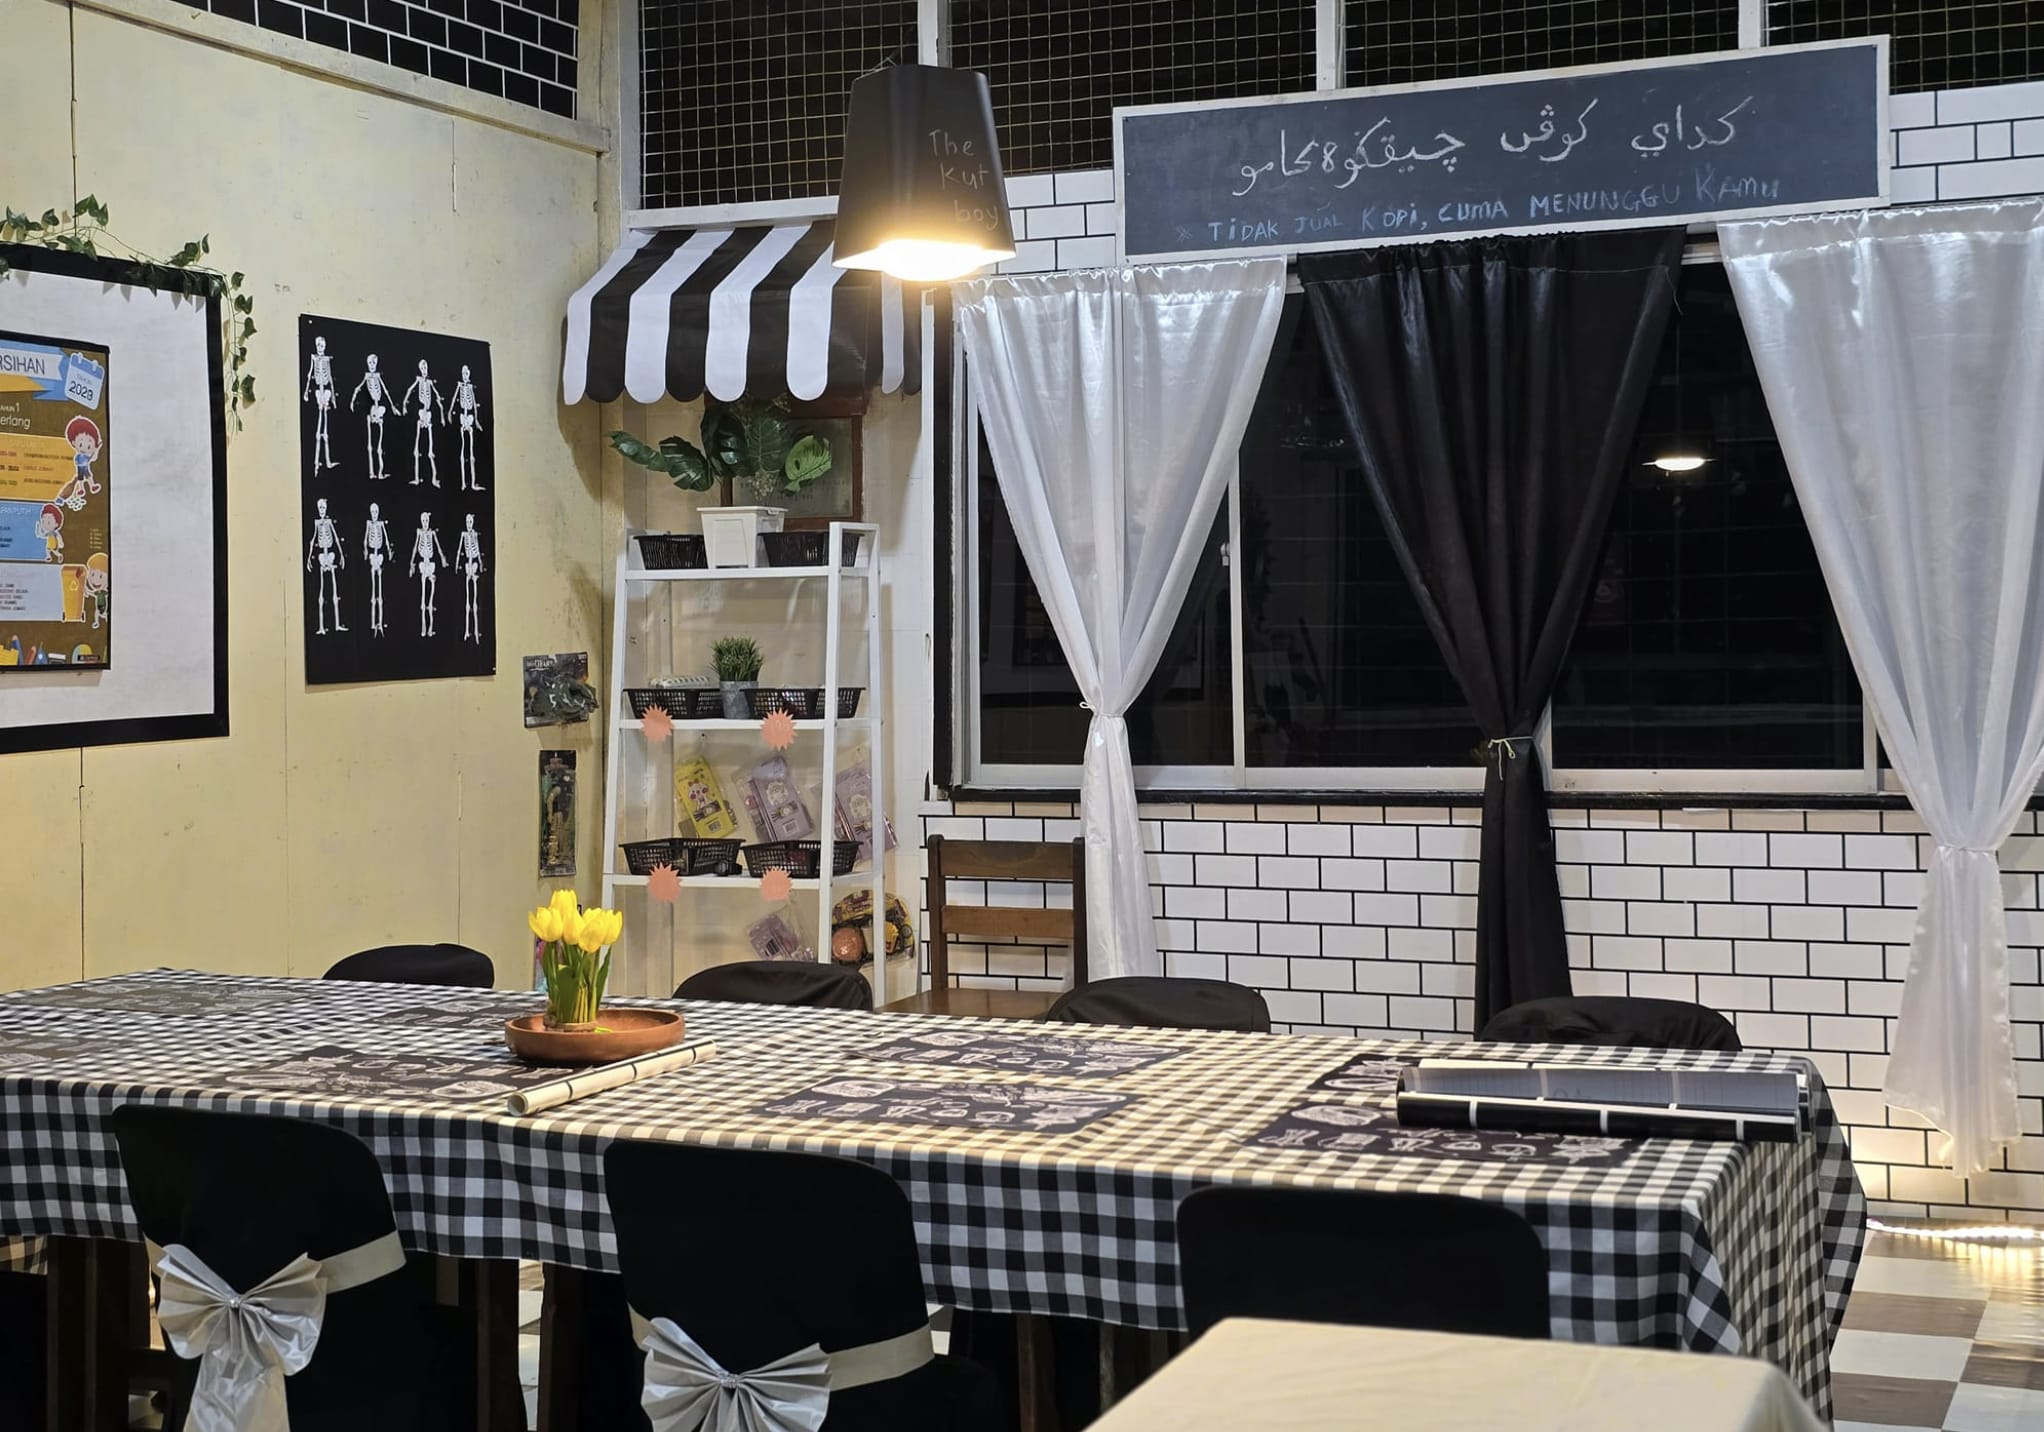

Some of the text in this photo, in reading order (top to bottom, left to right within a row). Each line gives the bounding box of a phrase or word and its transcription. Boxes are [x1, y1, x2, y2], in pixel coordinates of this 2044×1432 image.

[929, 129, 975, 157] The
[953, 199, 999, 231] boy
[1294, 213, 1344, 234] JUAL
[1529, 183, 1681, 219] MENUNGGU
